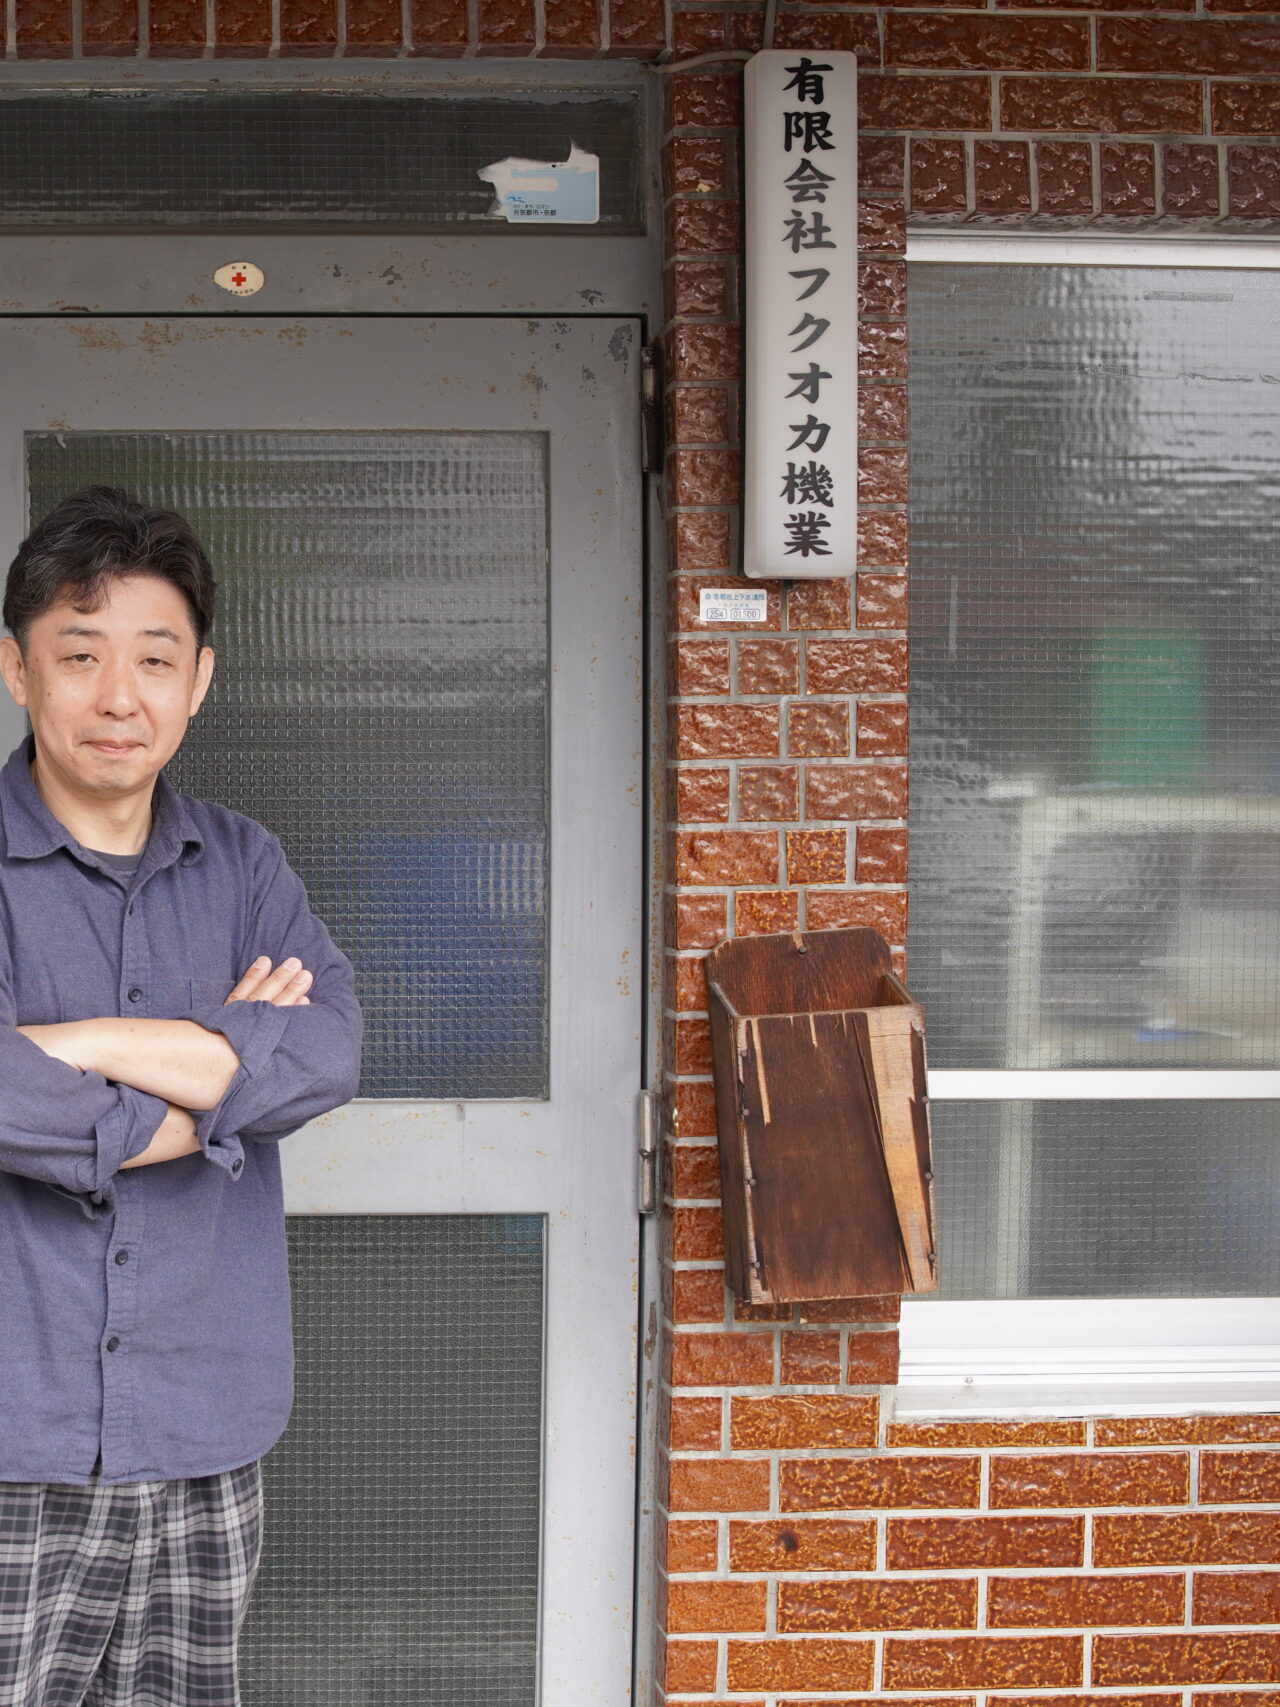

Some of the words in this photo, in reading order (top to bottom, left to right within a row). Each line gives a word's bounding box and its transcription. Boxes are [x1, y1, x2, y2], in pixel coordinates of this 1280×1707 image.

[780, 57, 837, 559] 有限会社フクオカ機業
